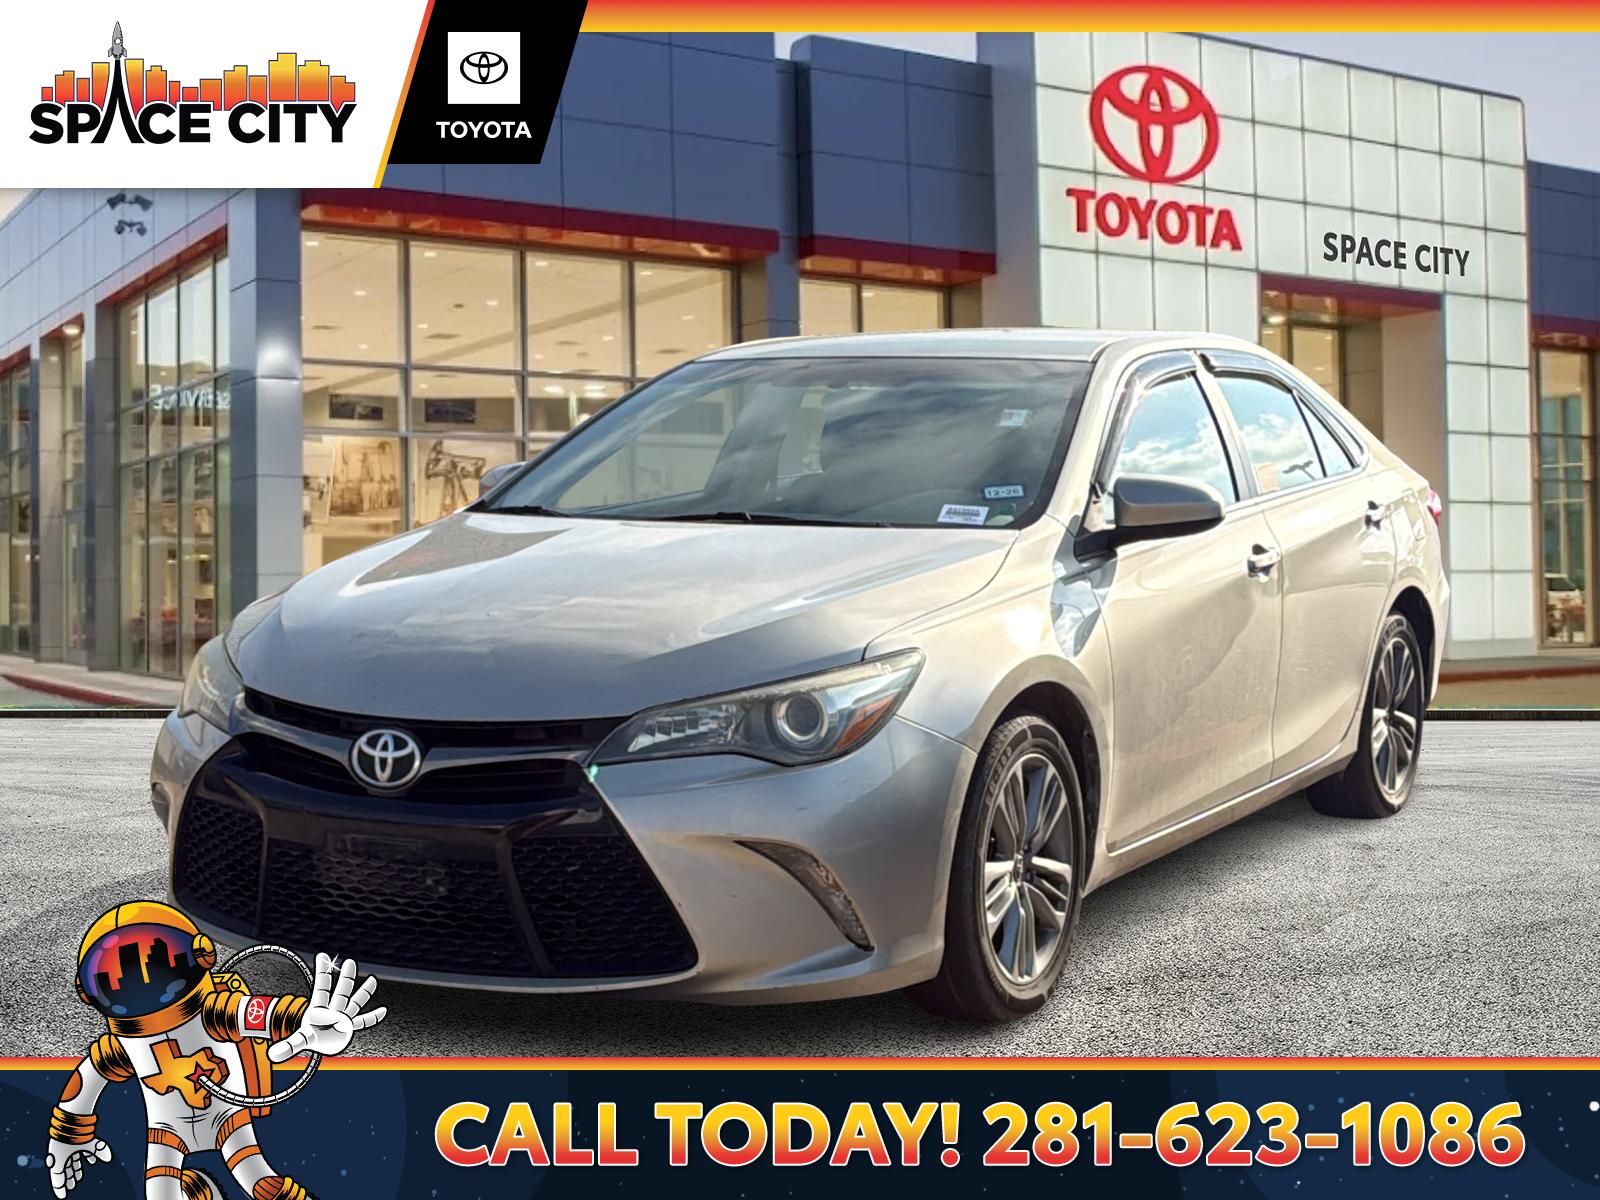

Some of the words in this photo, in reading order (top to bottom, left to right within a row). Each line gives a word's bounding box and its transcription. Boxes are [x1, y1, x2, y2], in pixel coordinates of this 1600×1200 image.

[1066, 187, 1243, 251] TOYOTA
[1323, 232, 1407, 270] SPACE
[1414, 244, 1470, 277] CITY
[987, 488, 1020, 497] 12-26
